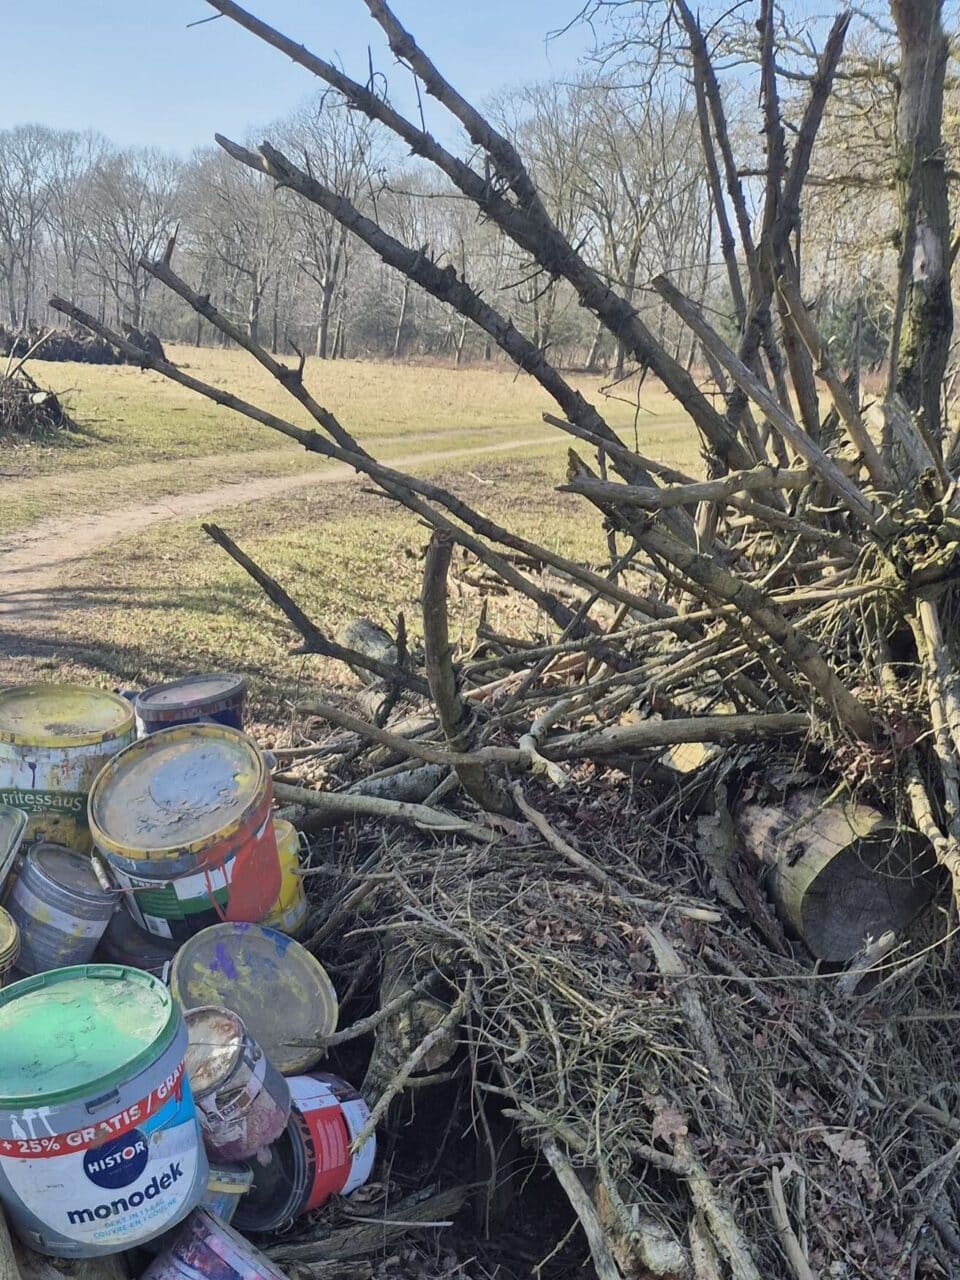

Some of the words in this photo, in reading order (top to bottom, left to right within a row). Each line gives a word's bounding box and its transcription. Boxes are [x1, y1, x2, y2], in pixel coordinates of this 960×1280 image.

[2, 791, 83, 811] Fritessaus
[17, 1138, 61, 1153] 25%
[66, 1105, 141, 1147] GRATIS
[88, 1140, 145, 1174] HISTOR
[67, 1161, 184, 1224] monodek
